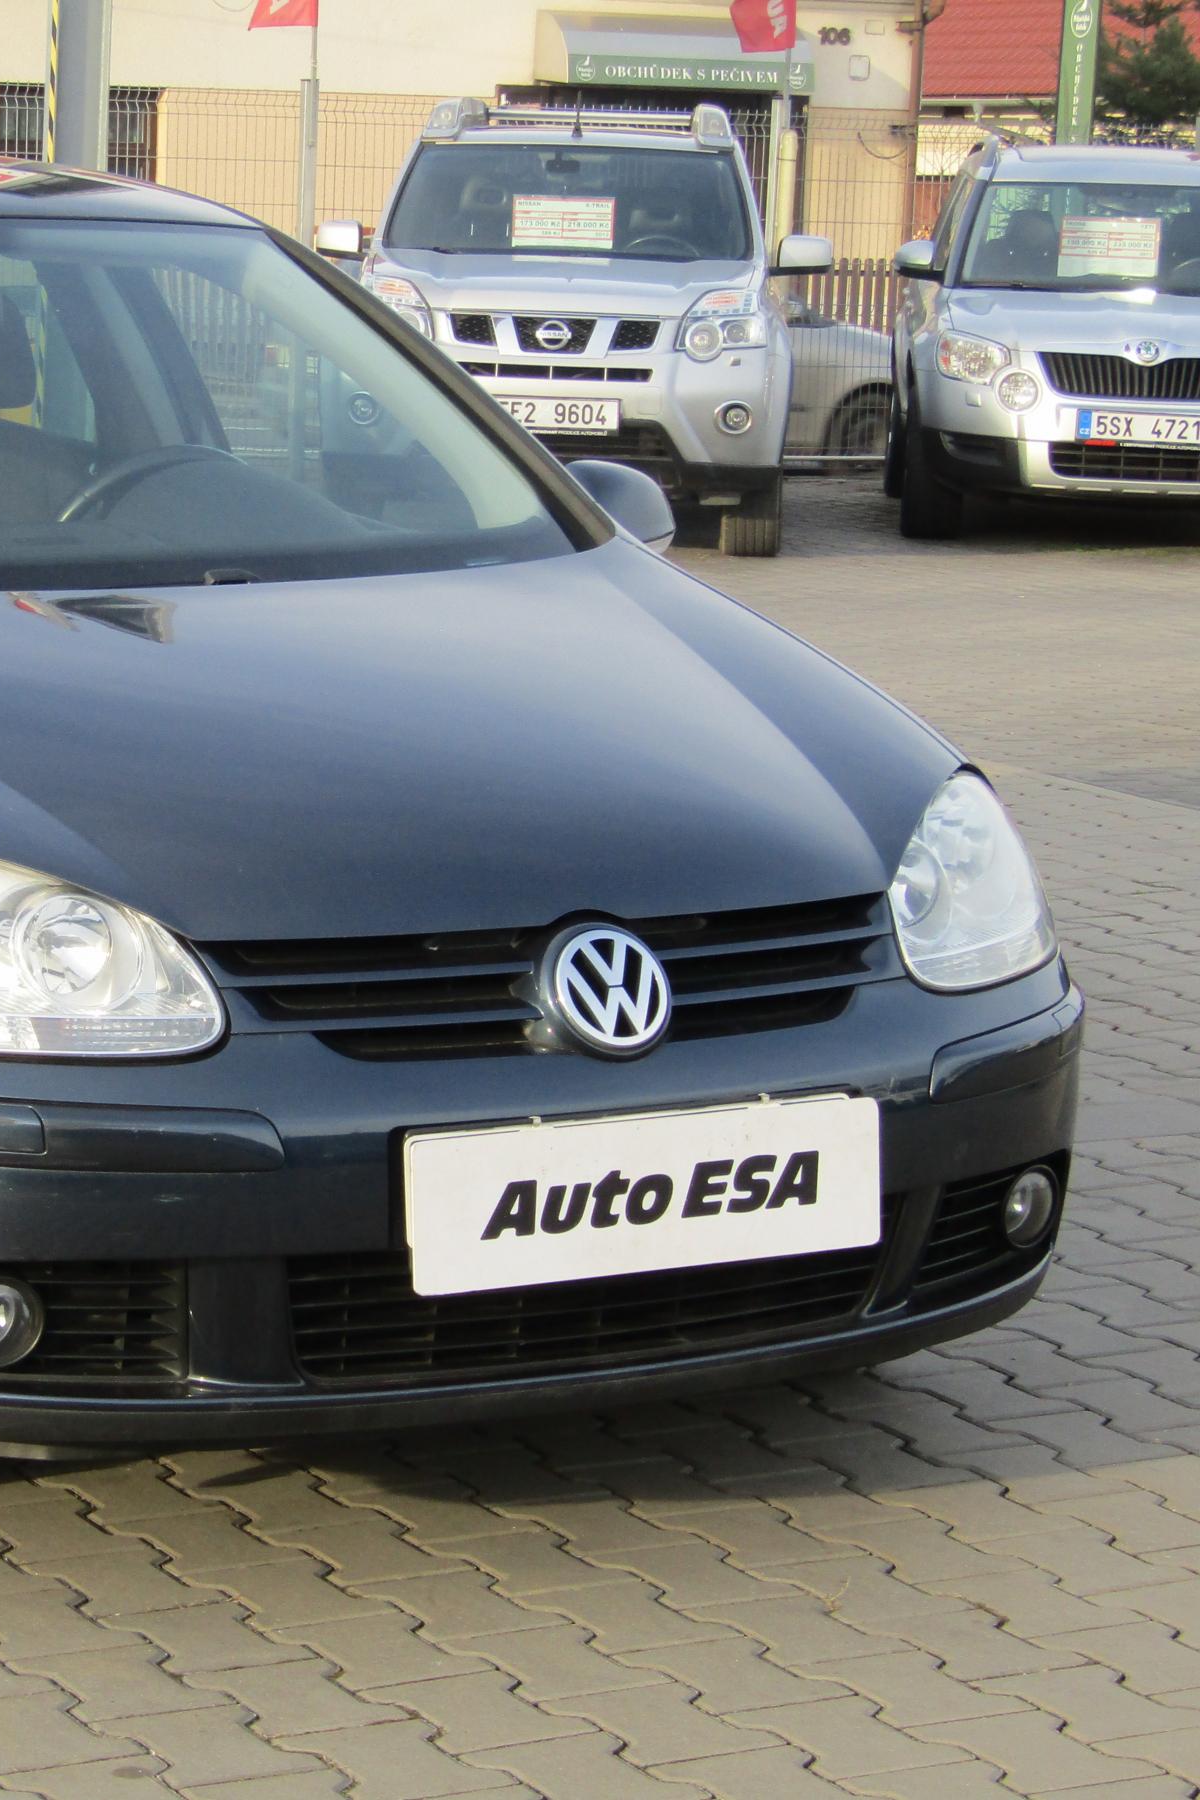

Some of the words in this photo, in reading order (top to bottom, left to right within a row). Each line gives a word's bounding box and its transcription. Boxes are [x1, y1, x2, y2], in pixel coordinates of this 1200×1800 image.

[817, 26, 851, 45] 106
[604, 63, 693, 81] OBCHŮDEK
[697, 68, 706, 81] S
[711, 67, 779, 84] PEČIVEM
[500, 402, 536, 424] E2
[554, 402, 608, 426] 9604
[1096, 415, 1134, 437] 5SX
[1151, 417, 1200, 441] 4721
[480, 1169, 674, 1241] Auto
[681, 1150, 819, 1220] ESA
